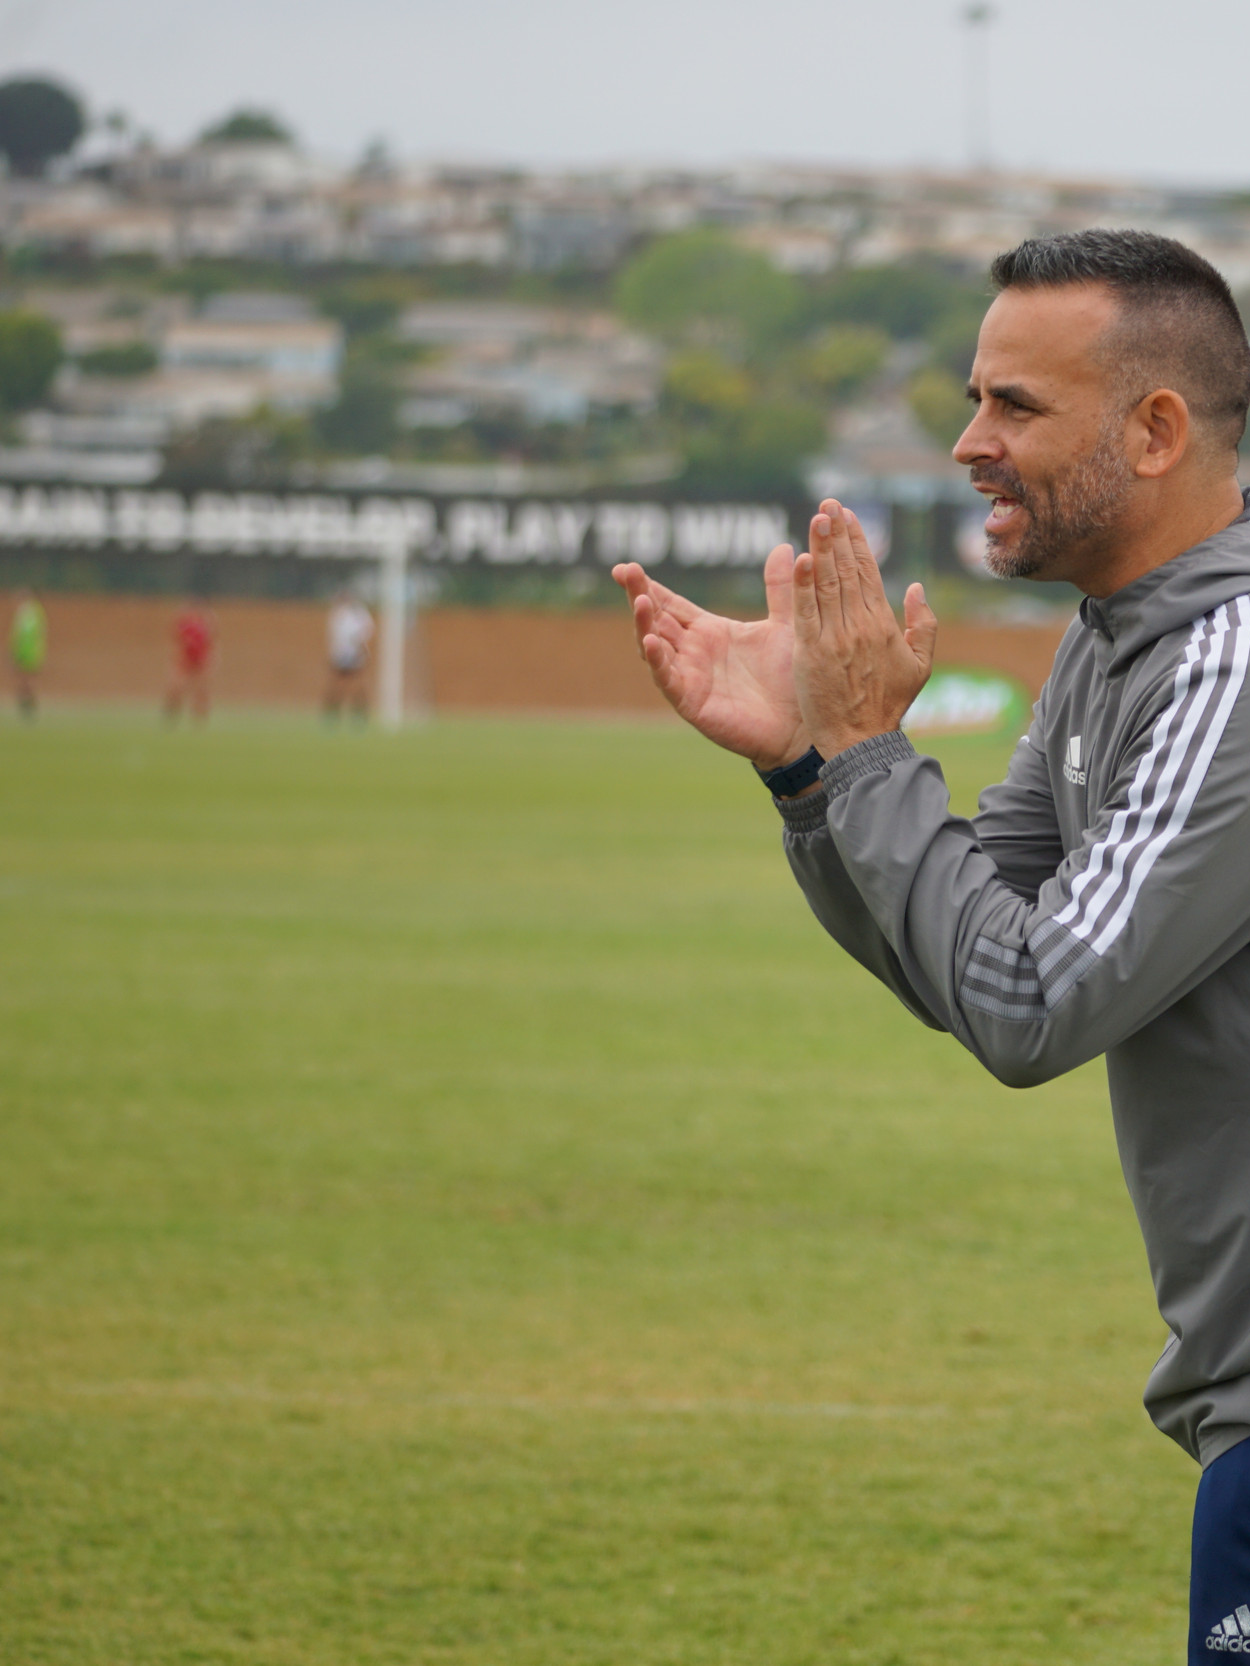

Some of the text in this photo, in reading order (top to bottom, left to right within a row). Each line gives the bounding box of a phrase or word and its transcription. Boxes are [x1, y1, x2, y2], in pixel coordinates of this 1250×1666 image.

[115, 489, 187, 553] TO
[449, 499, 597, 565] PLAY
[597, 502, 671, 566] TO
